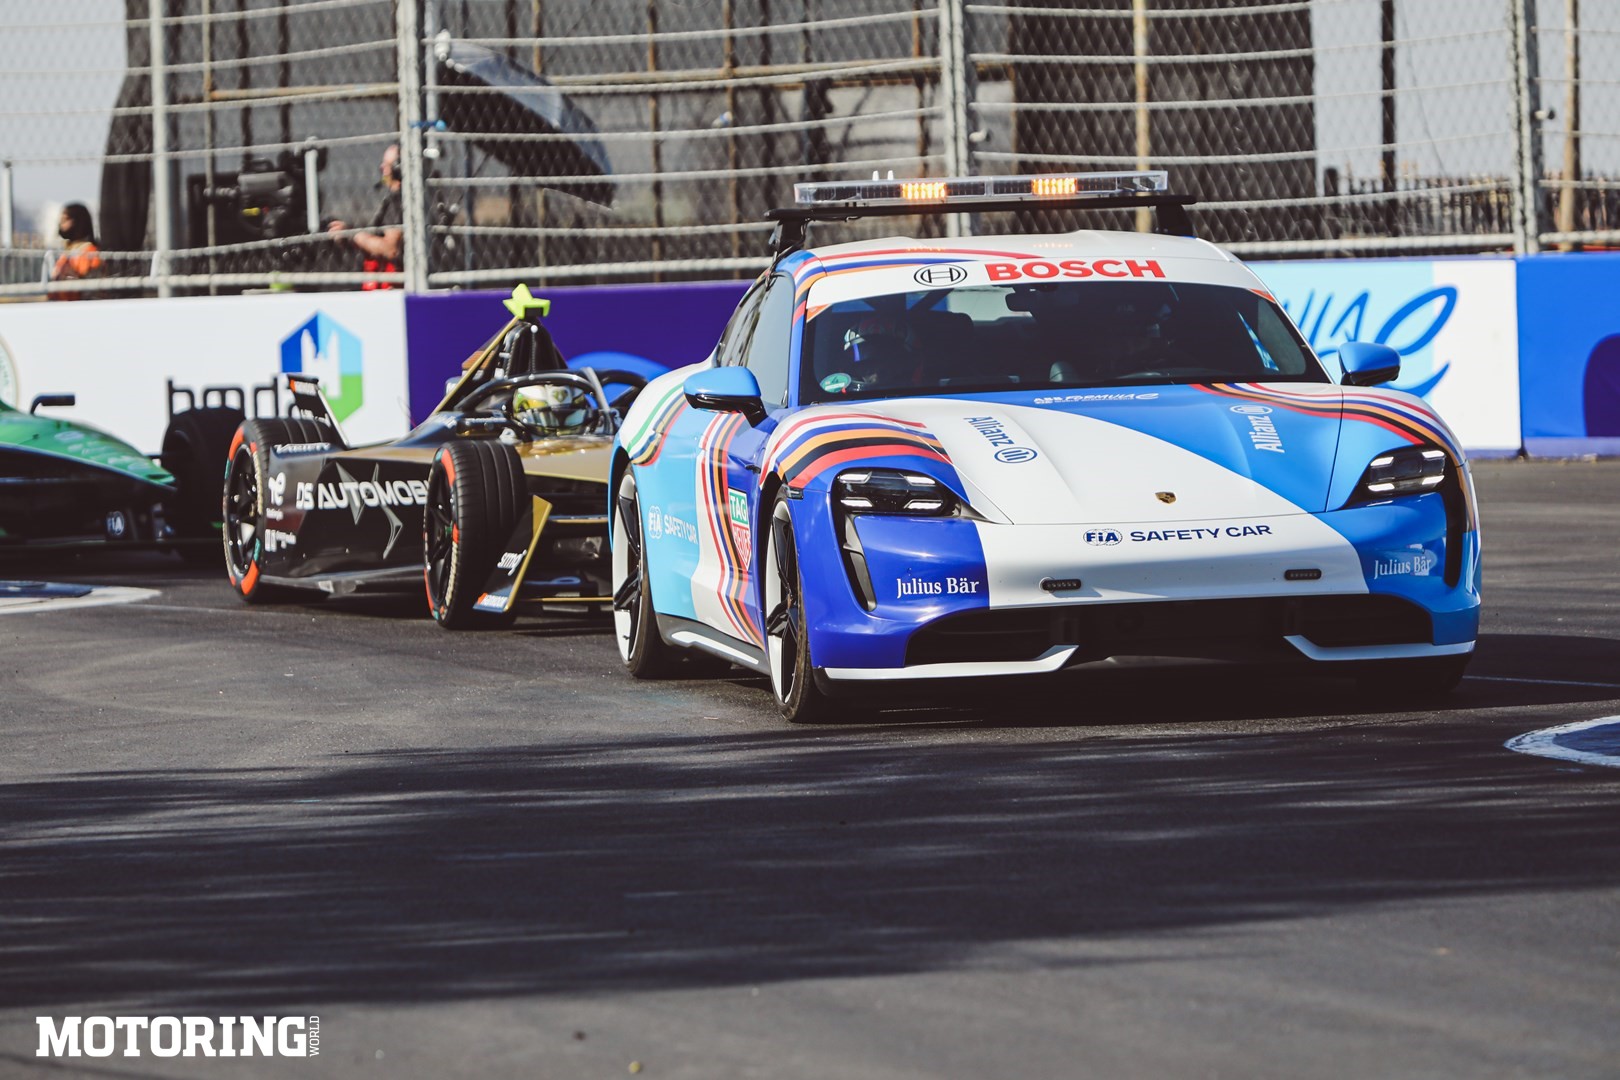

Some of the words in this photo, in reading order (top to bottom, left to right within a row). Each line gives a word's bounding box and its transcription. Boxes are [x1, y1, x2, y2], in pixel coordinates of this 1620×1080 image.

[985, 260, 1166, 281] BOSCH
[963, 416, 1015, 447] Allianz
[1247, 415, 1286, 454] Allianz
[295, 481, 315, 510] DS
[317, 480, 430, 510] AUTOMOB
[730, 495, 749, 522] TAG
[1130, 528, 1220, 542] SAFETY
[1225, 524, 1273, 538] CAR
[1374, 559, 1411, 580] Julius
[1413, 556, 1432, 574] Bär
[896, 578, 942, 599] Julius
[945, 577, 979, 594] Bär
